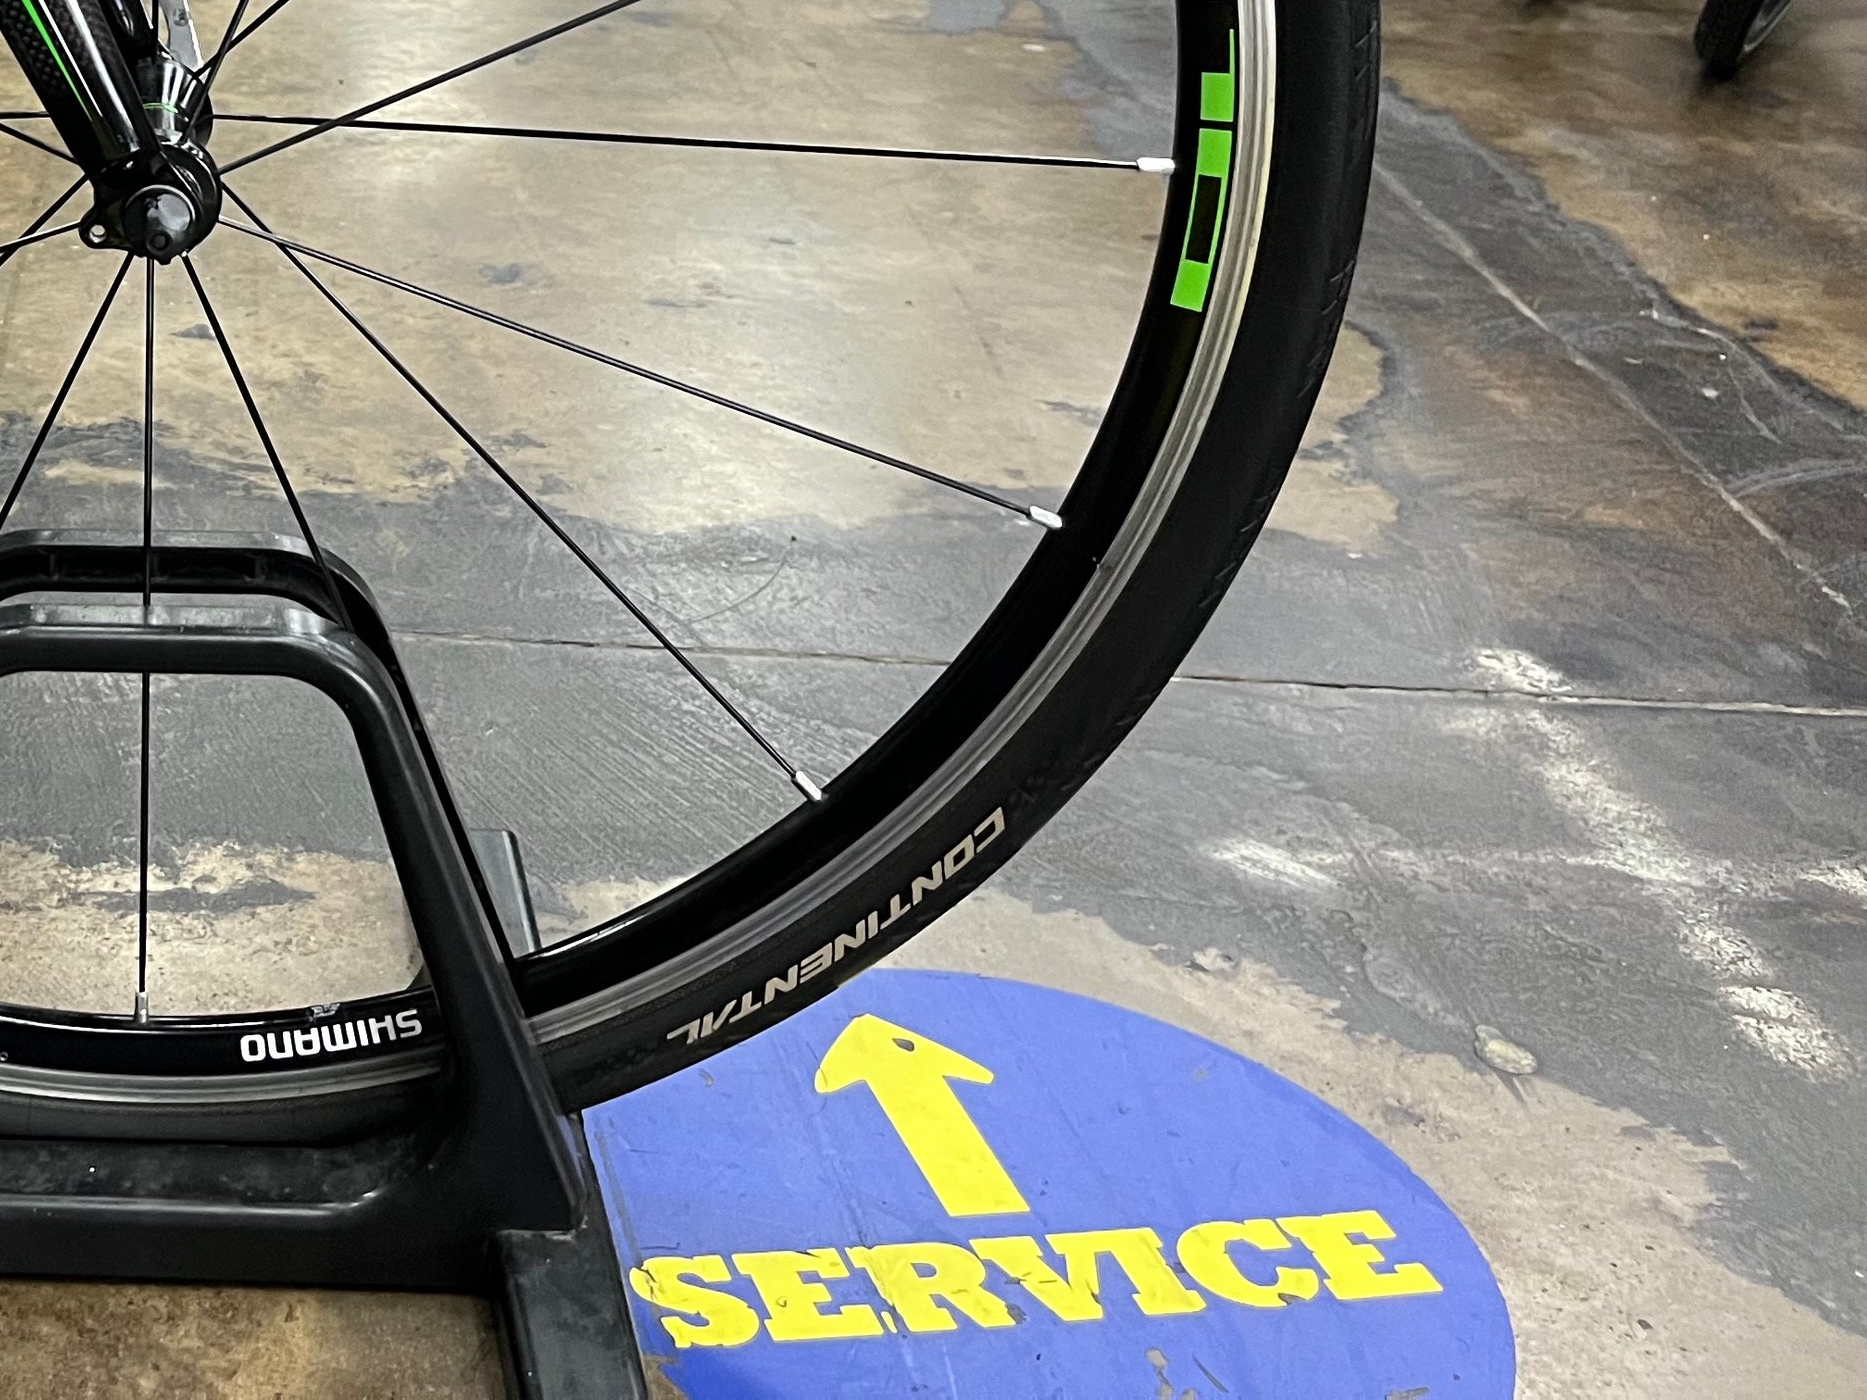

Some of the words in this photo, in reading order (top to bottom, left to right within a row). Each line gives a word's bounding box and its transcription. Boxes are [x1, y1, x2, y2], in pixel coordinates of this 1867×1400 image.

[666, 806, 1006, 1045] CONTINENTAL
[239, 1008, 423, 1063] SHIMANO
[628, 1209, 1445, 1349] SERVICE
